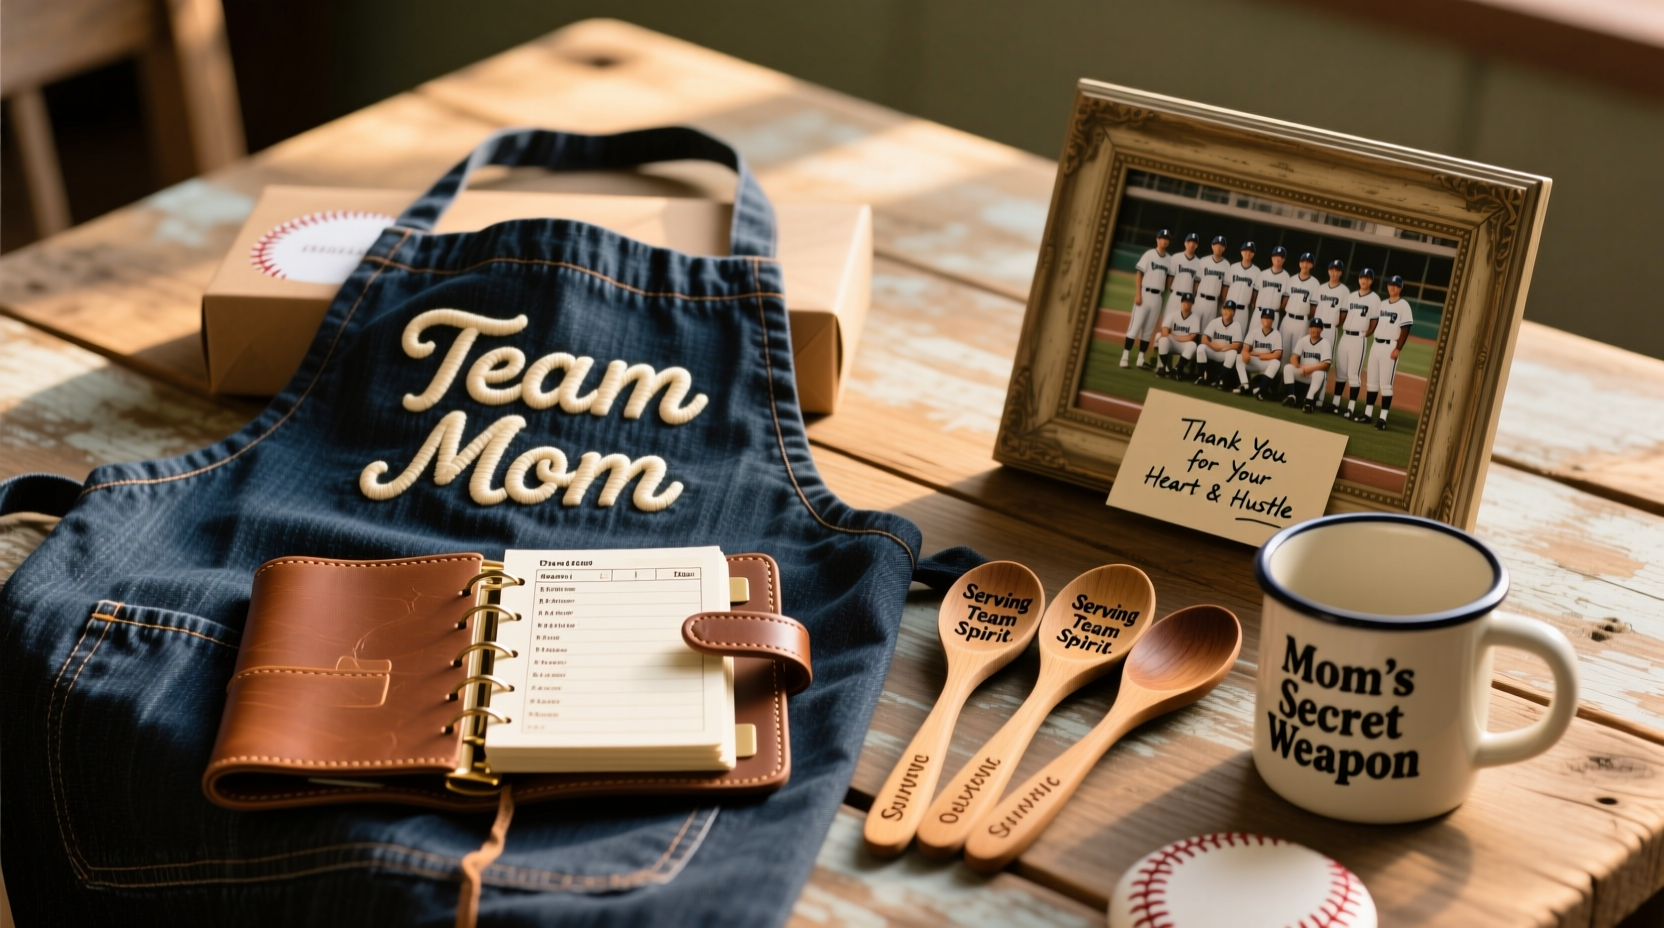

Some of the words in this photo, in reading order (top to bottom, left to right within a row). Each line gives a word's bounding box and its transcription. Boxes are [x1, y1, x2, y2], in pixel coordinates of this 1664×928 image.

[402, 308, 709, 425] Team
[1181, 417, 1242, 451] Thank
[1250, 437, 1287, 463] You
[359, 410, 684, 512] Mom
[1187, 449, 1219, 472] for
[1226, 460, 1272, 486] Your
[1144, 466, 1201, 495] Heart
[1206, 483, 1221, 503] &
[1229, 489, 1293, 519] Hustle
[963, 583, 1034, 615] Serving
[967, 604, 1018, 627] Team
[1071, 594, 1140, 628] Serving
[954, 621, 1013, 643] Spirit.
[1056, 628, 1112, 655] Spirit.
[1073, 613, 1121, 639] Team
[1281, 634, 1415, 697] Mom's
[1278, 678, 1404, 740] Secret
[1267, 711, 1420, 786] Weapon
